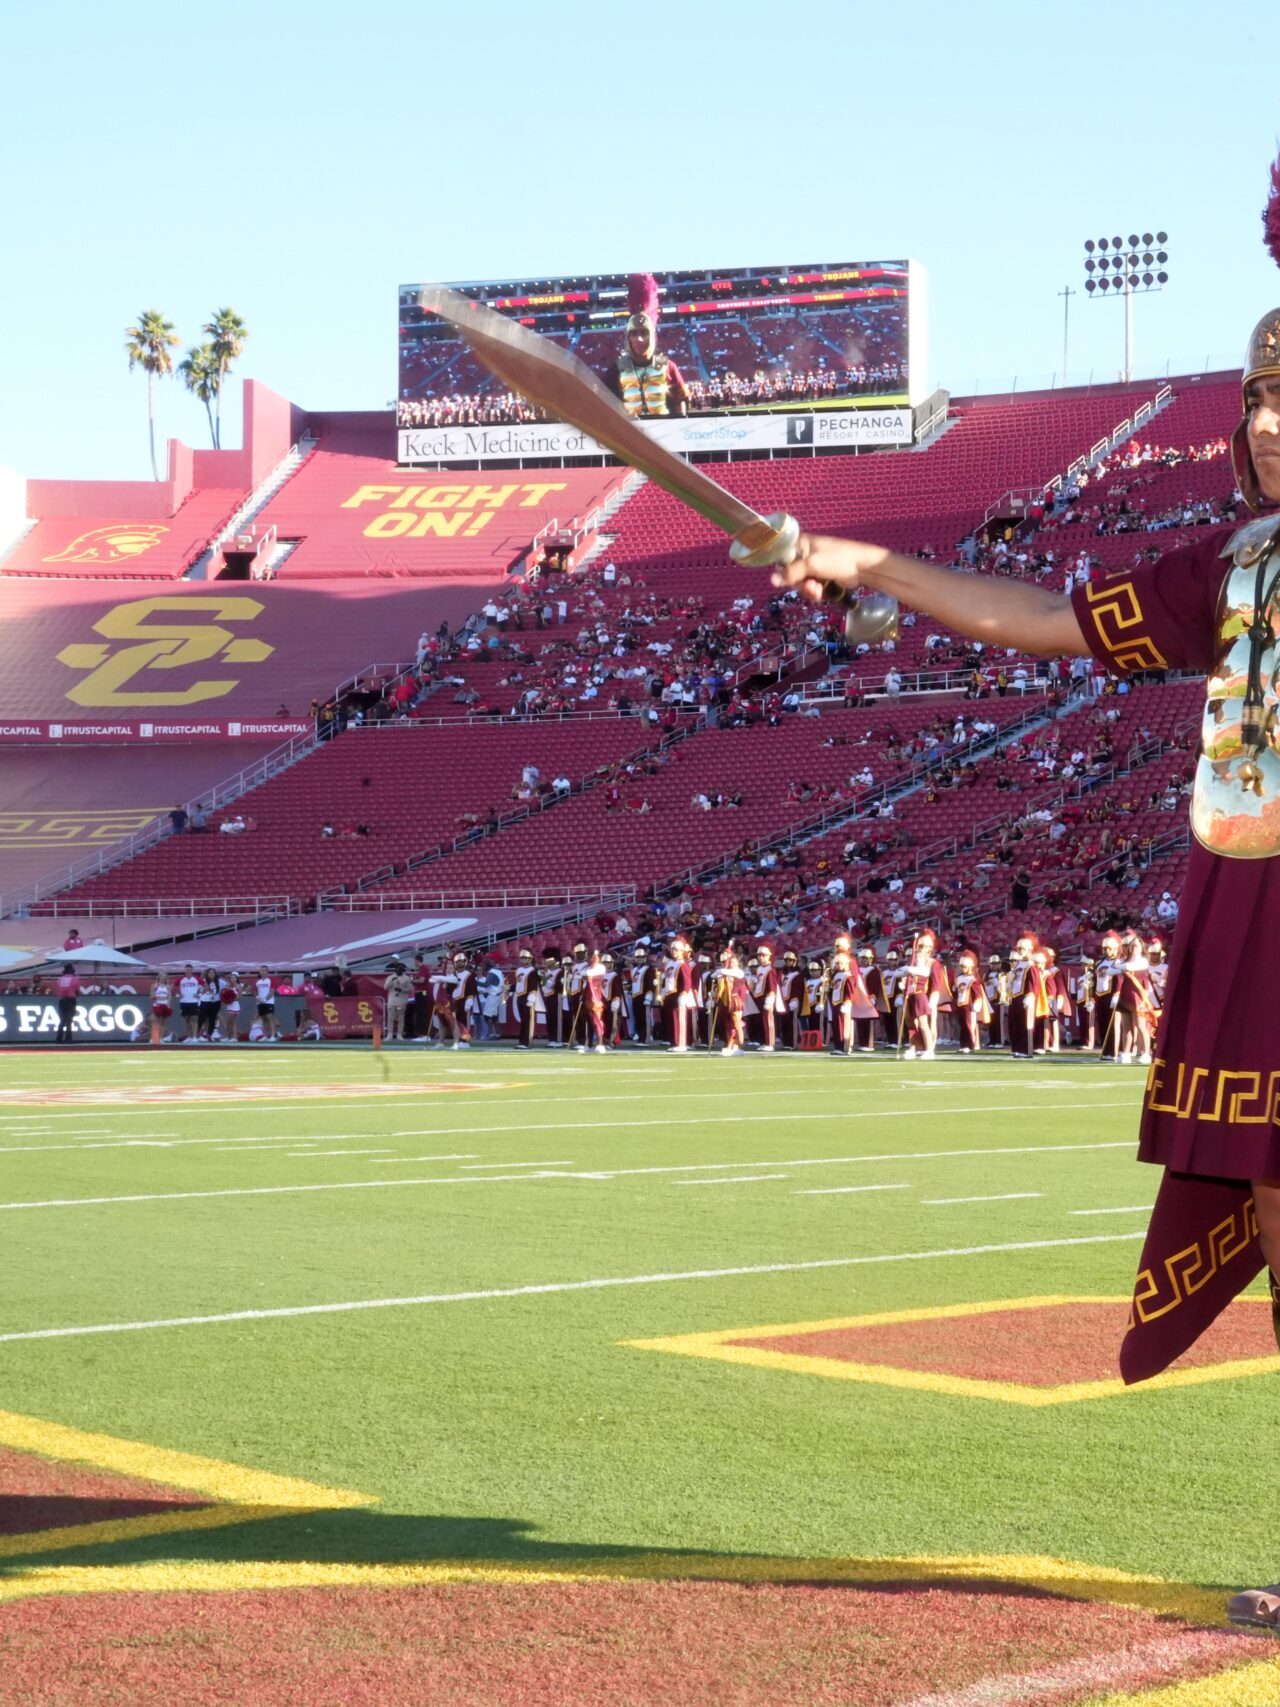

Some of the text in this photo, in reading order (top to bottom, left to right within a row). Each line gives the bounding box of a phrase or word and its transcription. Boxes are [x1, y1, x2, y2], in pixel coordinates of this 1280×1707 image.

[820, 417, 904, 430] PECHANGA
[405, 433, 456, 457] Keck
[464, 427, 561, 456] Medicine
[566, 430, 588, 451] of
[683, 428, 747, 441] SmartStop
[819, 429, 905, 440] RESORT CASINO
[340, 483, 568, 508] FIGHT
[363, 511, 496, 538] ON!
[63, 726, 133, 735] ITRUSTCAPITAL
[154, 725, 221, 734] ITRUSTCAPITAL
[242, 724, 308, 733] ITRUSTCAPITAL
[16, 1004, 144, 1032] FARGO
